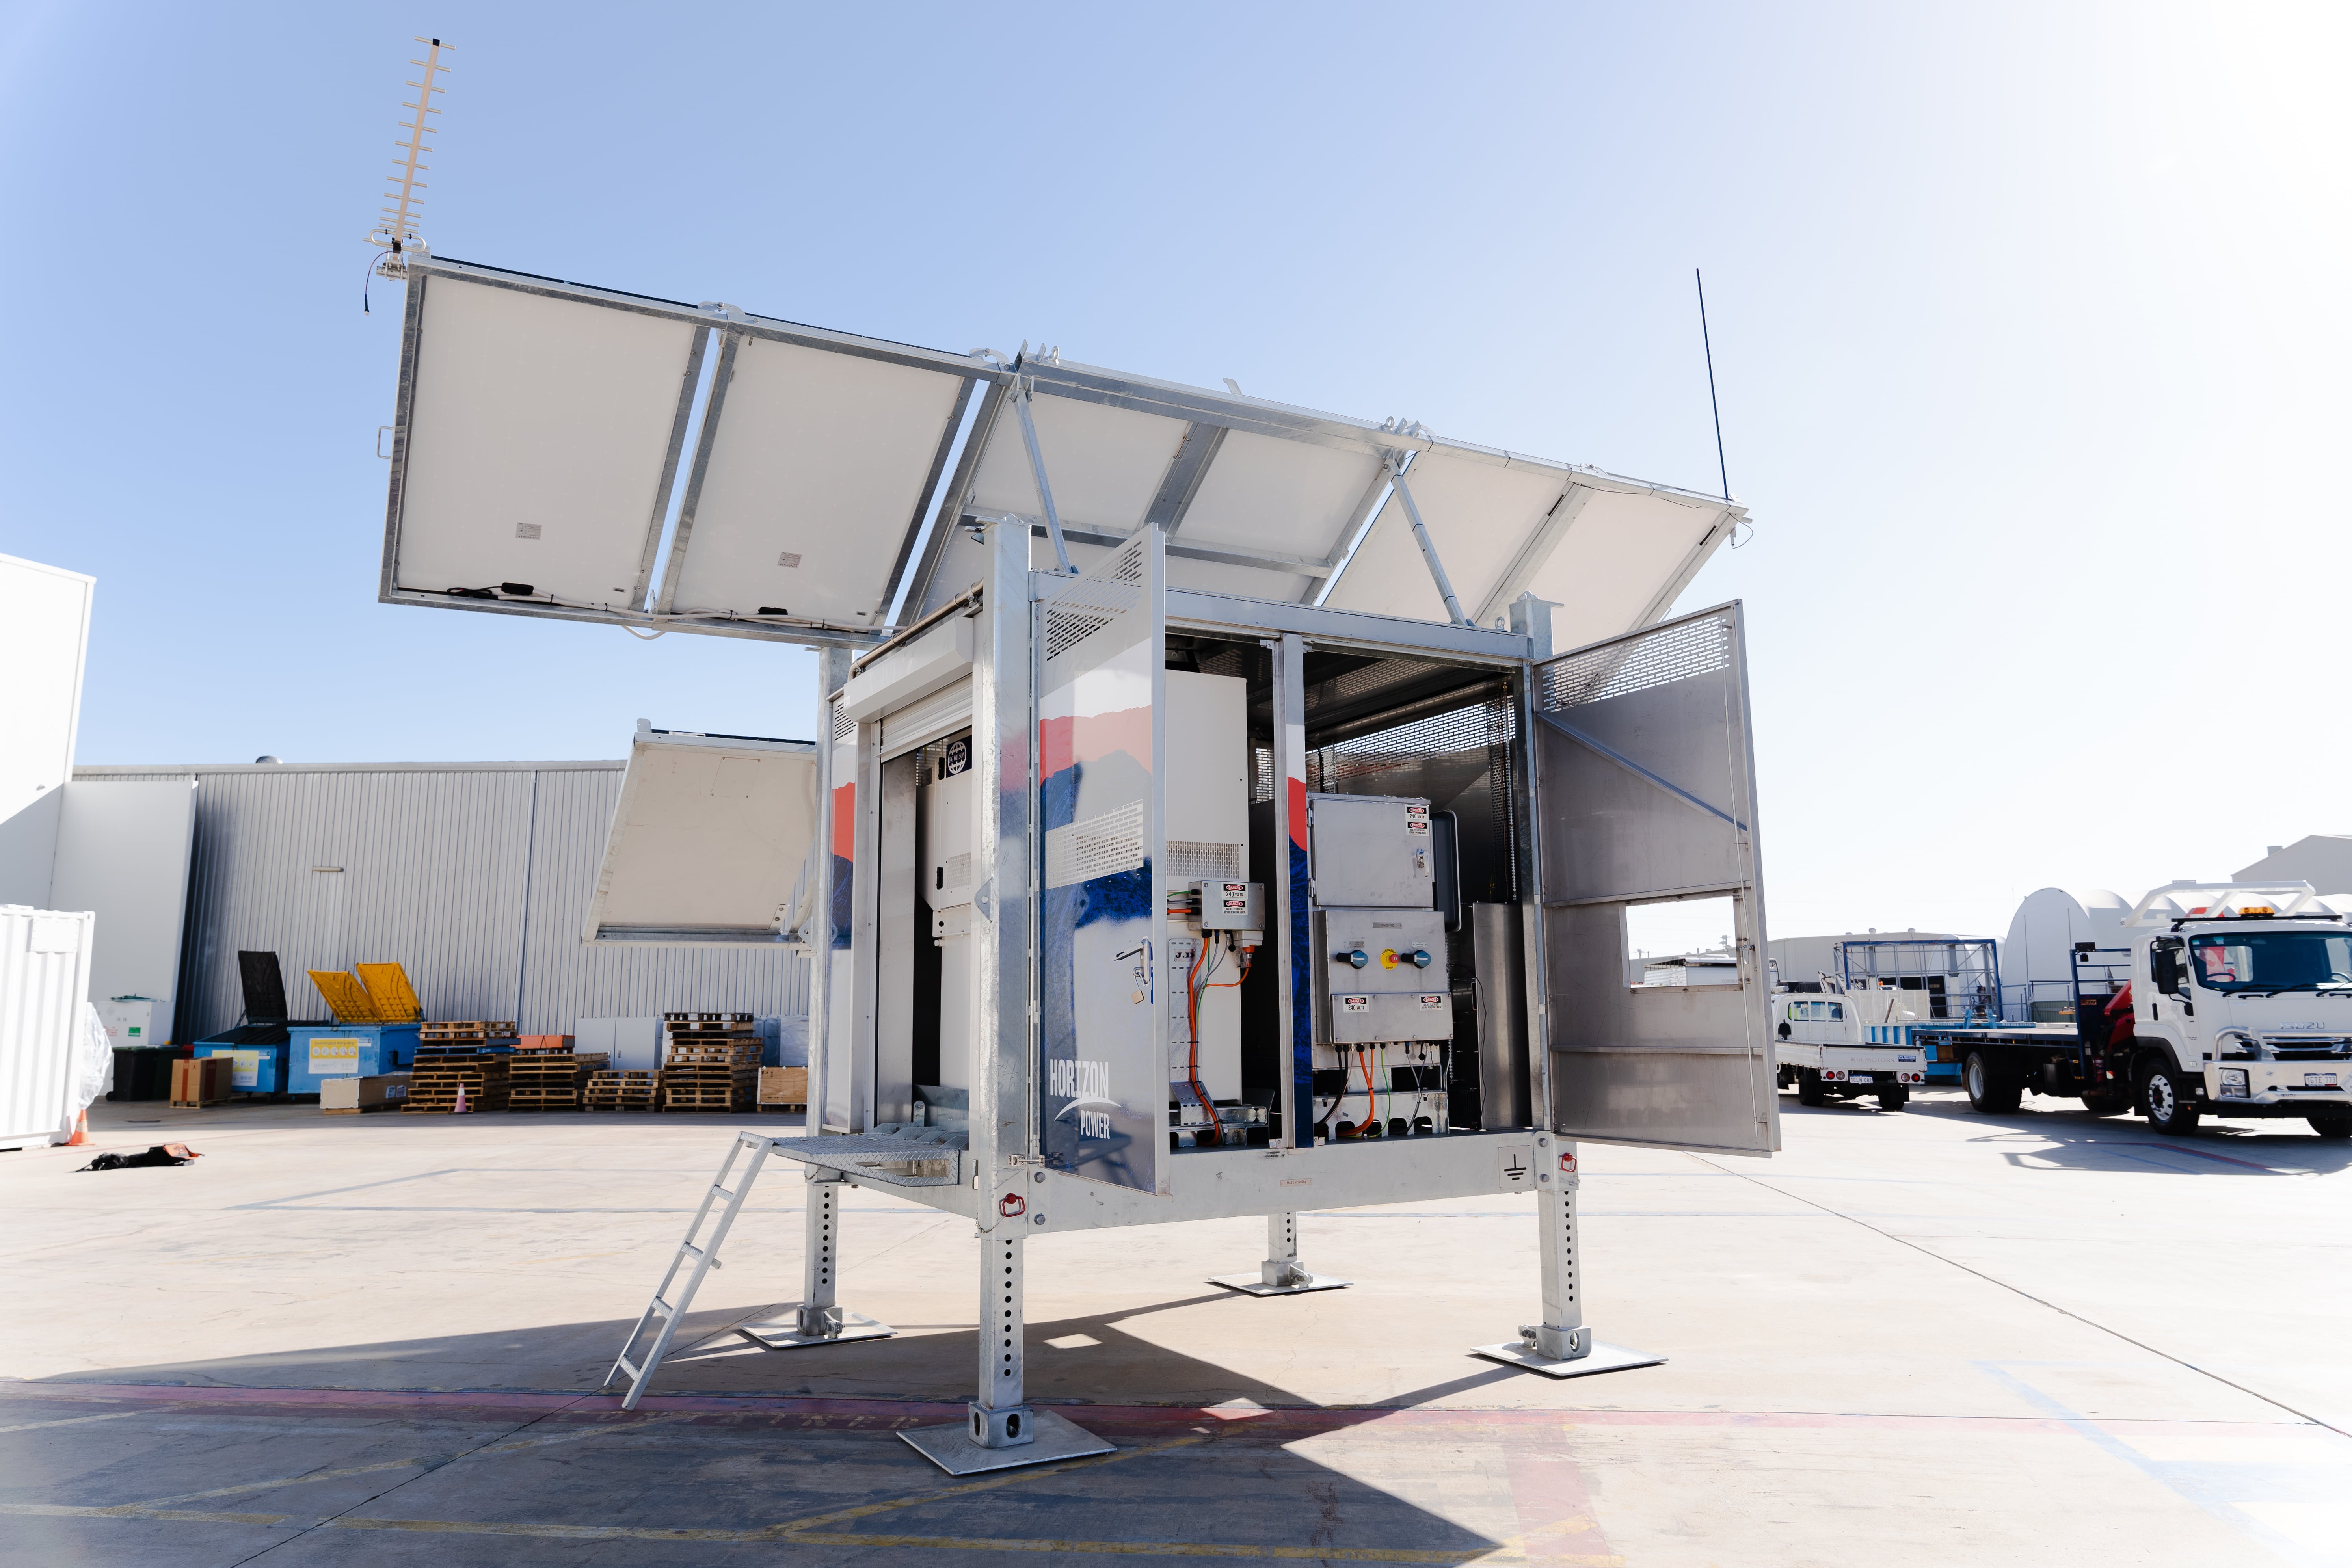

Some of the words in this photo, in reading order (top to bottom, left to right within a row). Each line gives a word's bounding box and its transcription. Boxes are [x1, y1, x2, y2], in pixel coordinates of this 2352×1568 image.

[954, 751, 965, 761] WILSON
[2280, 1021, 2325, 1030] ISUZU
[1050, 1059, 1109, 1099] HORIZON
[1080, 1110, 1110, 1140] POWER
